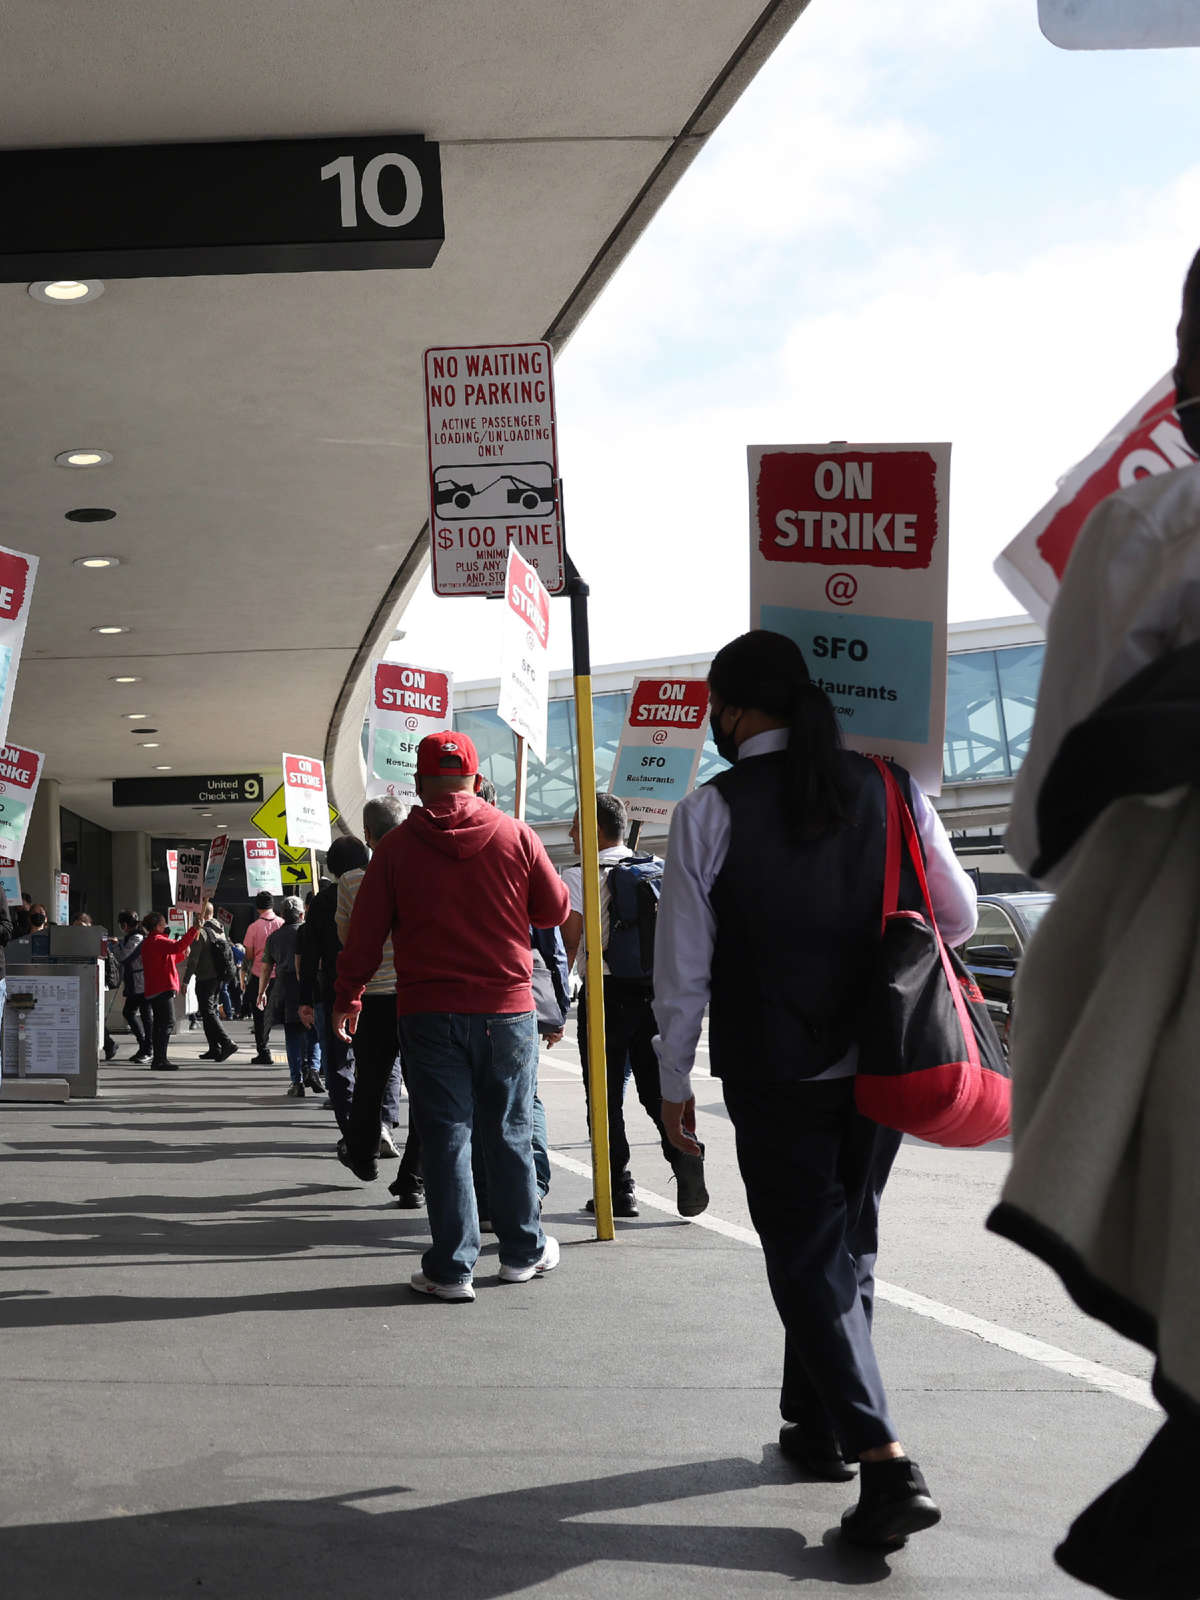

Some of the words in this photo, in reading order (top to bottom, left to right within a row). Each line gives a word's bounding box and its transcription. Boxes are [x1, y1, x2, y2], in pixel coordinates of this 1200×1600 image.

[320, 152, 424, 228] 10
[433, 356, 458, 378] NO
[466, 352, 543, 377] WAITING
[431, 384, 456, 407] NO
[464, 381, 546, 406] PARKING
[441, 417, 476, 431] ACTIVE
[482, 415, 541, 429] PASSENGER
[434, 428, 550, 445] LOADING/UNLOADING
[478, 445, 504, 457] ONLY
[814, 461, 873, 501] ON
[438, 526, 496, 550] $100
[506, 524, 553, 546] FINE
[774, 508, 918, 553] STRIKE
[476, 551, 508, 560] MINIMU
[456, 562, 479, 572] PLUS
[483, 561, 501, 571] ANY
[466, 574, 485, 584] AND
[825, 572, 858, 607] @
[812, 635, 869, 662] SFO
[400, 670, 426, 689] ON
[658, 682, 686, 700] ON
[808, 678, 898, 702] staurants
[382, 688, 442, 712] STRIKE
[636, 704, 700, 722] STRIKE
[404, 716, 418, 731] @
[652, 729, 668, 744] @
[298, 760, 312, 773] ON
[641, 756, 666, 768] SFO
[207, 780, 238, 790] United
[290, 772, 321, 787] STRIKE
[626, 774, 675, 784] Restaurants
[198, 791, 239, 801] Check-in
[244, 780, 259, 799] 9
[179, 854, 202, 866] ONE
[182, 866, 200, 874] JOB
